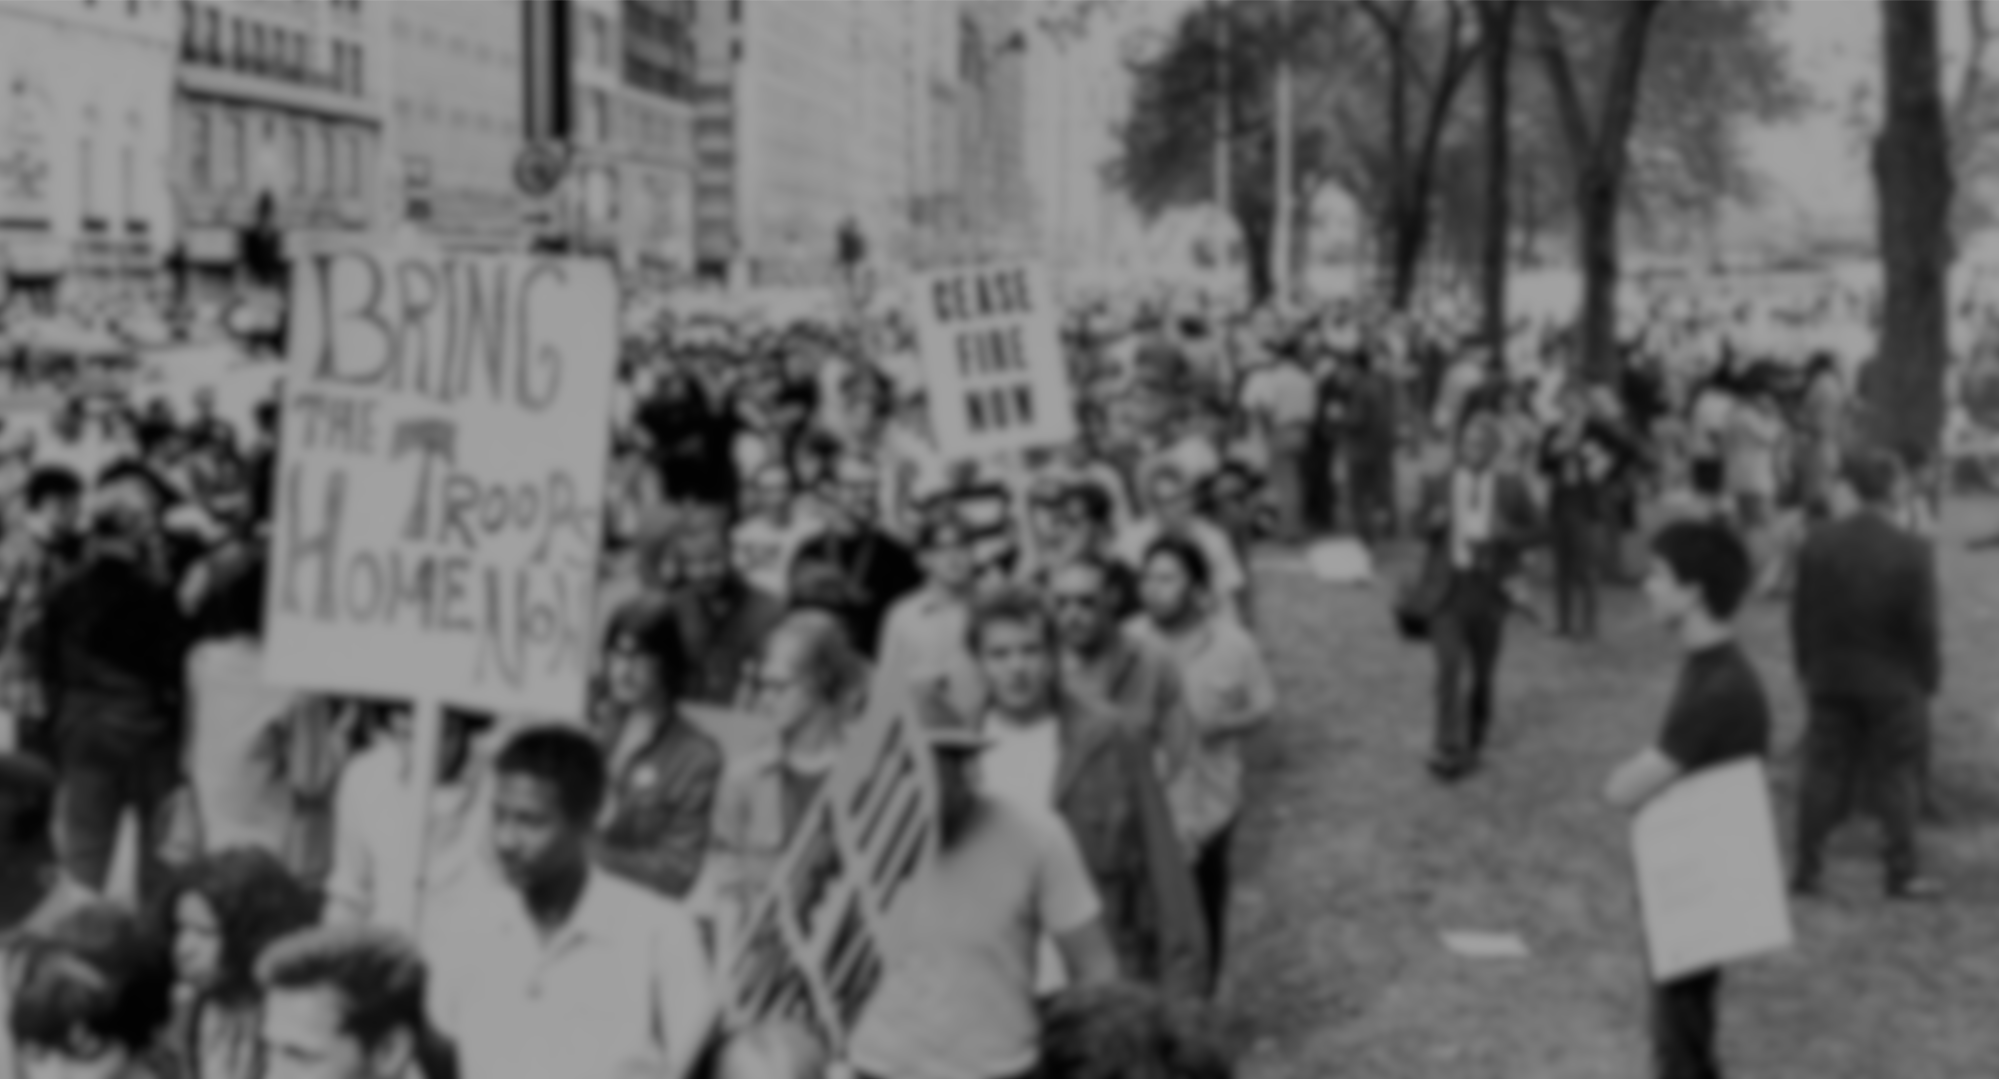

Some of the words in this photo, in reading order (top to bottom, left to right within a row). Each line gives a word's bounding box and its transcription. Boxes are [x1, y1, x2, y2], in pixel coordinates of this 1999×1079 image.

[932, 268, 1032, 322] CEASE
[311, 250, 567, 412] BRING
[955, 325, 1027, 377] FIRE
[294, 392, 379, 456] THE
[966, 384, 1034, 433] NOW
[283, 463, 475, 633] HOME
